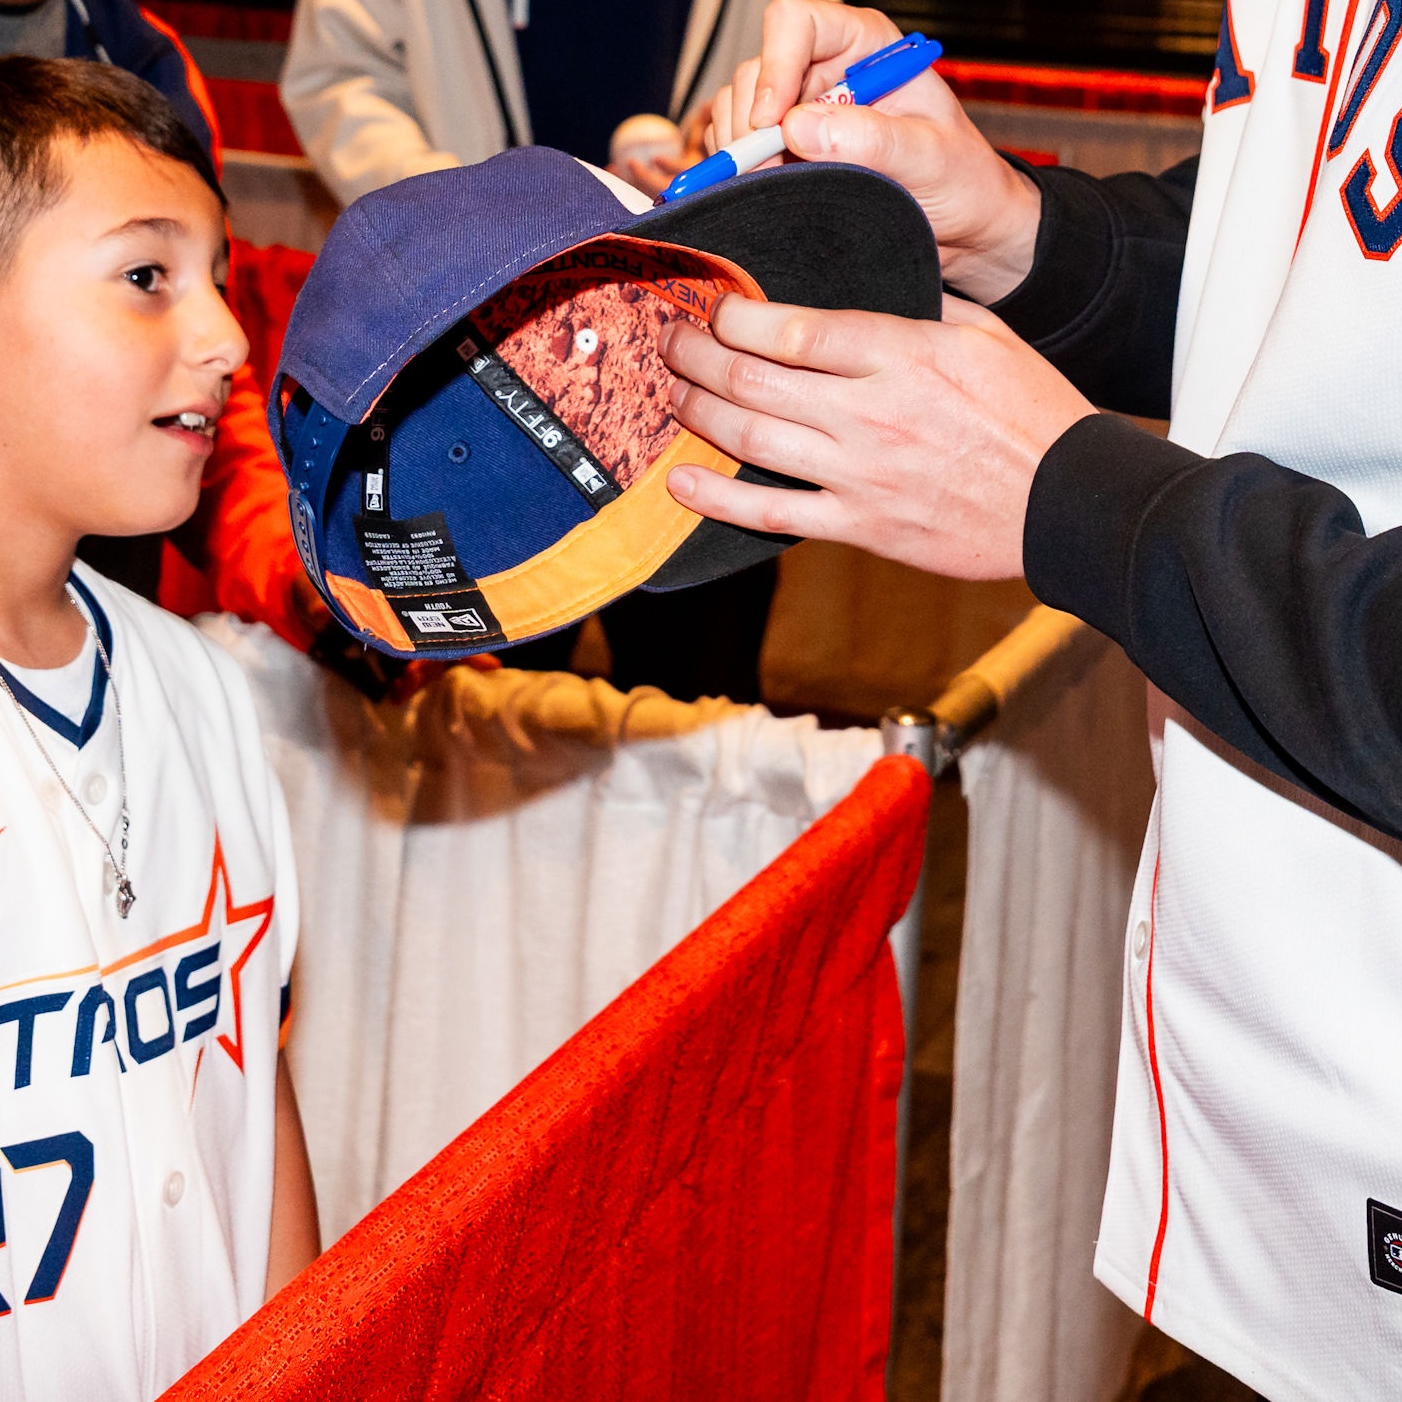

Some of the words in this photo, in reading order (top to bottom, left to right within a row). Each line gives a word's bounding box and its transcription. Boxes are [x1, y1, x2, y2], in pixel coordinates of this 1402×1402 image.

[650, 270, 707, 313] NEXT
[498, 389, 563, 449] 9FIFTY
[424, 602, 452, 610] YOUTH
